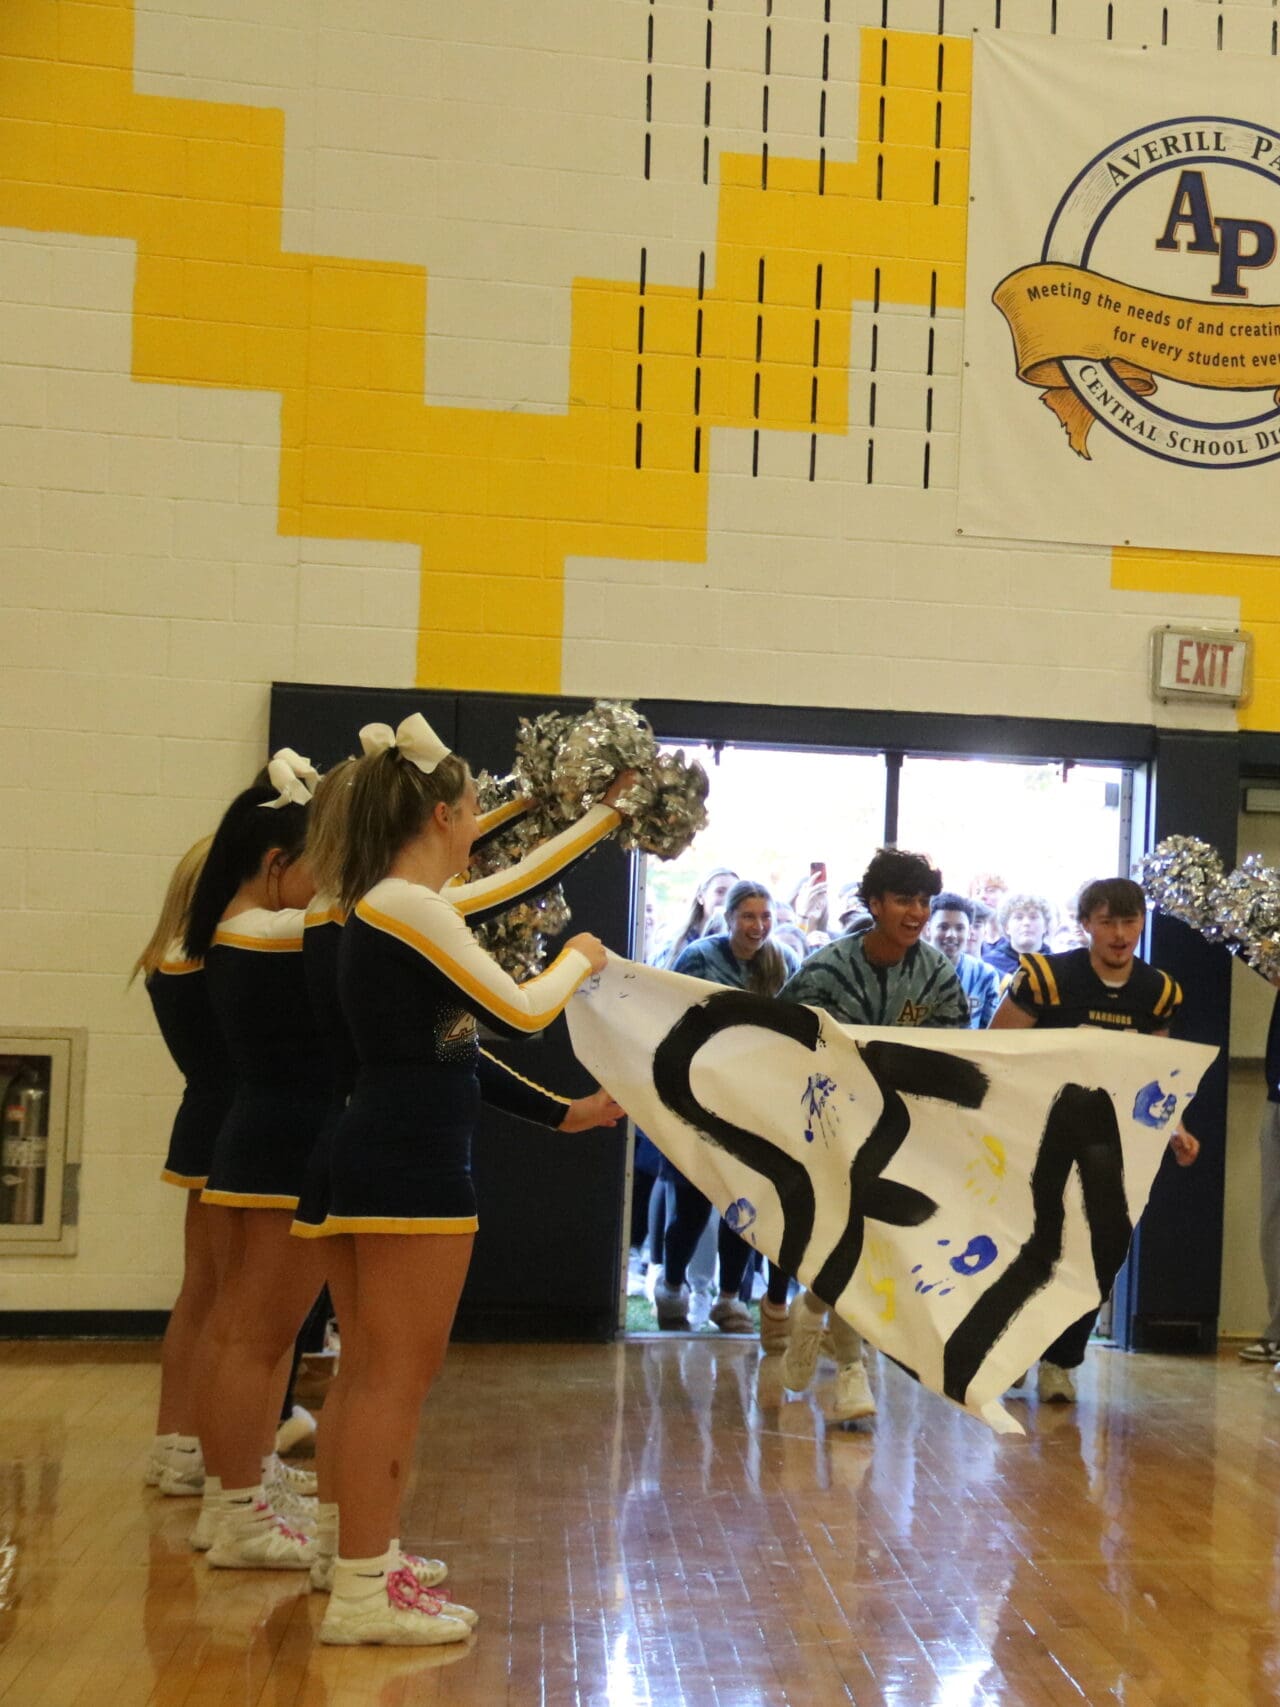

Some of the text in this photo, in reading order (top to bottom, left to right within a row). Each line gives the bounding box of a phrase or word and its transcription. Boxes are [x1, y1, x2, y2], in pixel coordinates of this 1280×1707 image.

[1104, 130, 1227, 187] AVERILL
[1155, 170, 1277, 298] AP
[1026, 281, 1092, 307] Meeting
[1097, 292, 1122, 313] the
[1127, 303, 1171, 327] needs
[1176, 316, 1193, 331] of
[1197, 320, 1224, 336] and
[1113, 325, 1135, 344] for
[1140, 334, 1183, 361] every
[1187, 348, 1247, 367] student
[1078, 363, 1158, 442] CENTRAL
[1166, 430, 1249, 455] SCHOOL
[1176, 640, 1234, 688] EXIT
[1088, 1010, 1134, 1025] WARRIORS
